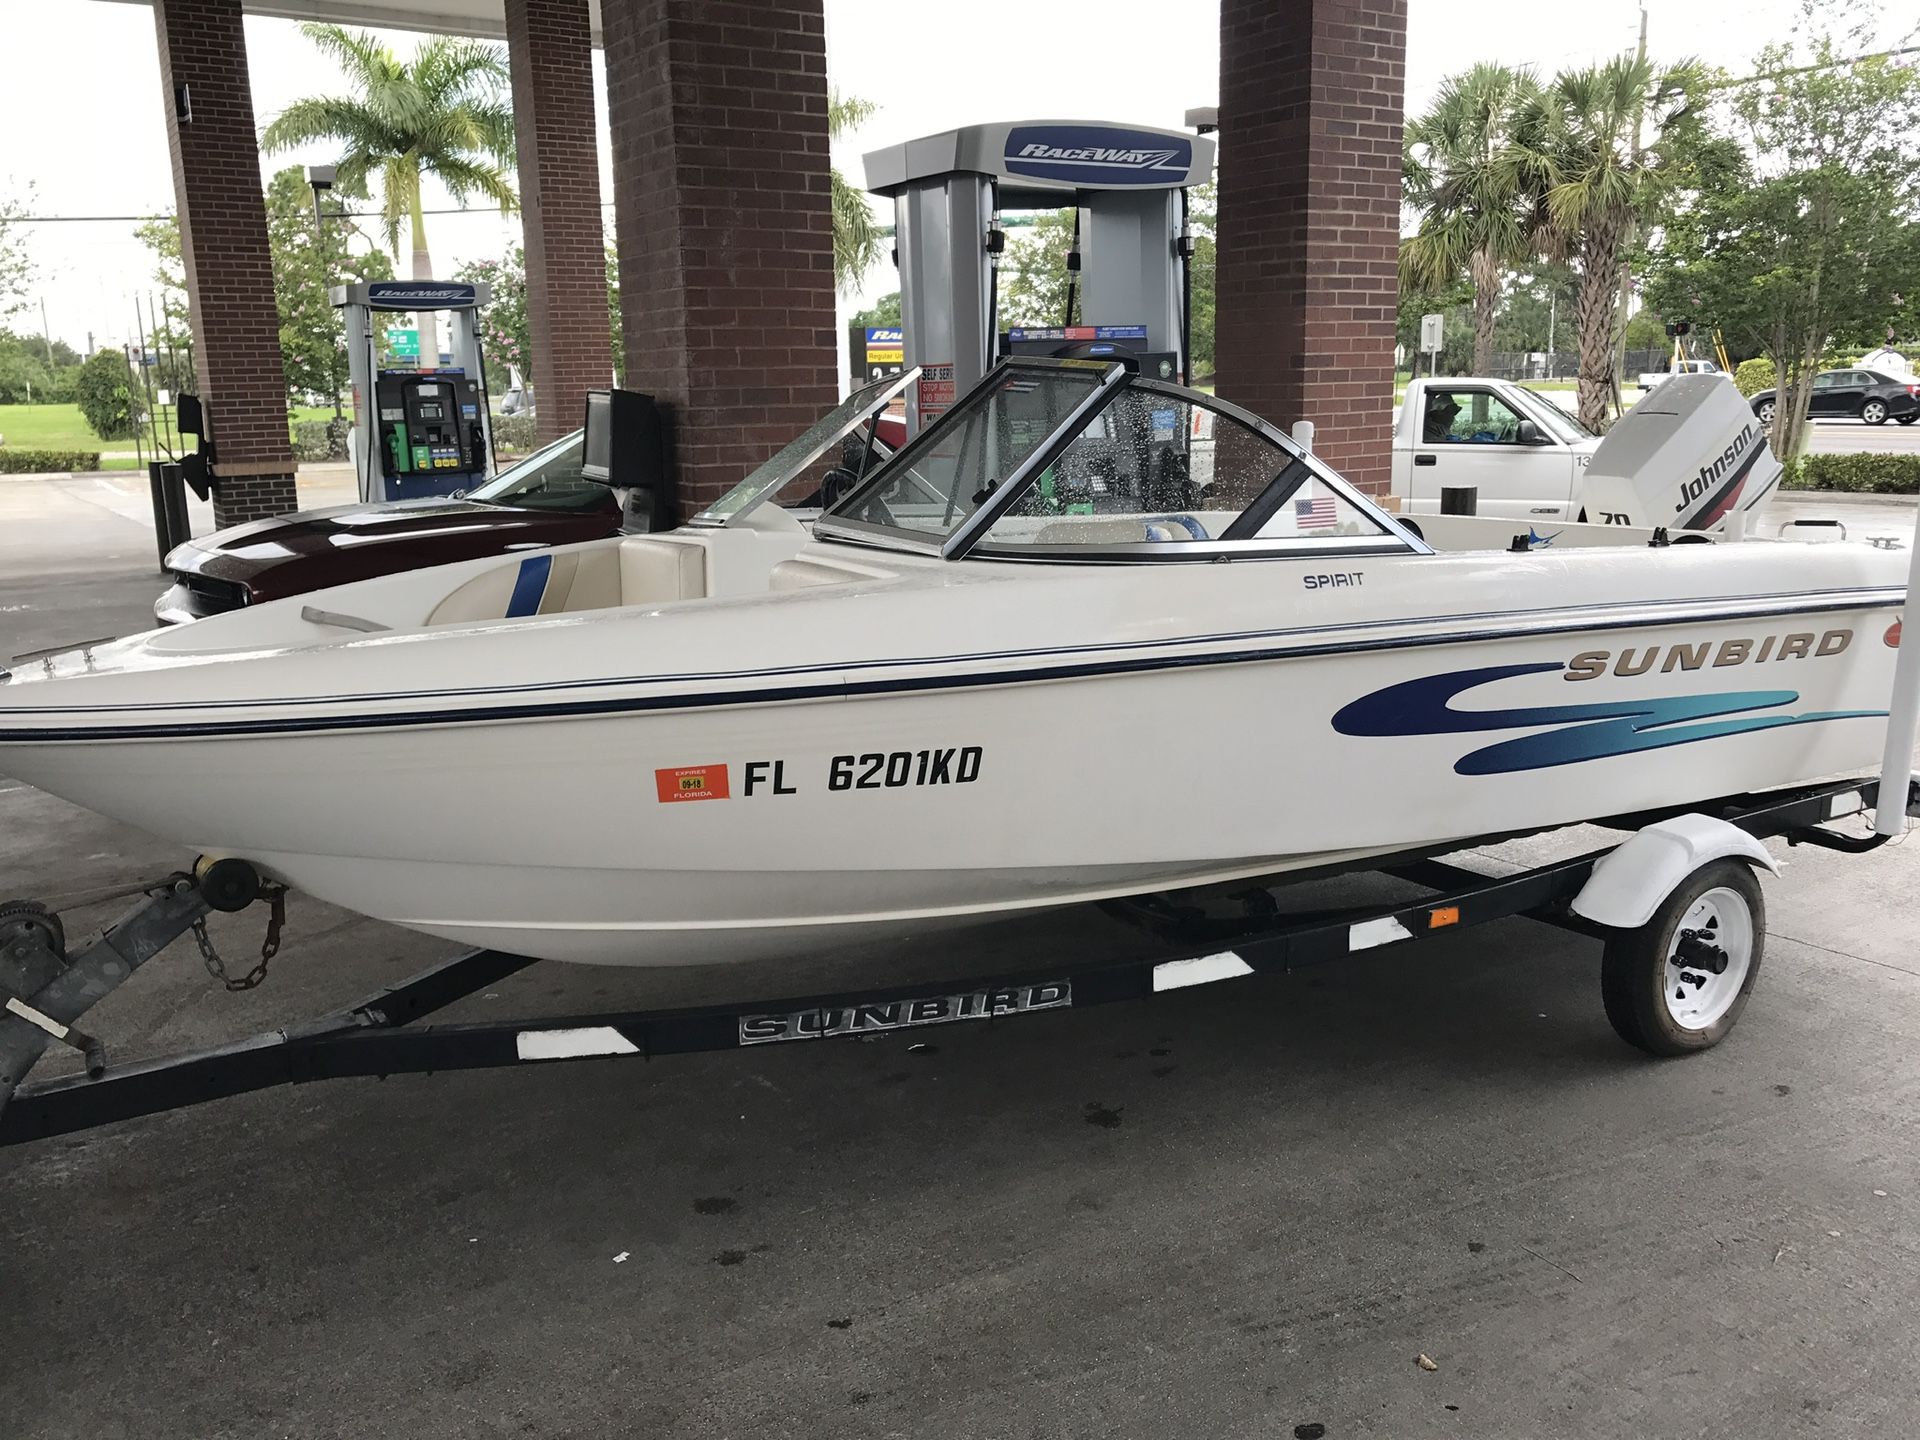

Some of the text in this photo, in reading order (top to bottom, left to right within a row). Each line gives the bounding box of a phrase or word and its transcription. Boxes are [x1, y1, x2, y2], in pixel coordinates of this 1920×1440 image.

[922, 368, 937, 381] SELF
[922, 383, 937, 392] STOP
[1675, 423, 1754, 513] Johnson
[1303, 572, 1364, 589] SPIRIT
[1563, 629, 1854, 682] SUNBIRD
[675, 769, 706, 777] EXPIRES
[744, 746, 983, 797] FL 6201KD
[682, 779, 702, 790] 09-18
[673, 791, 713, 799] FLORIDA
[741, 982, 1071, 1041] SUNBIRD
